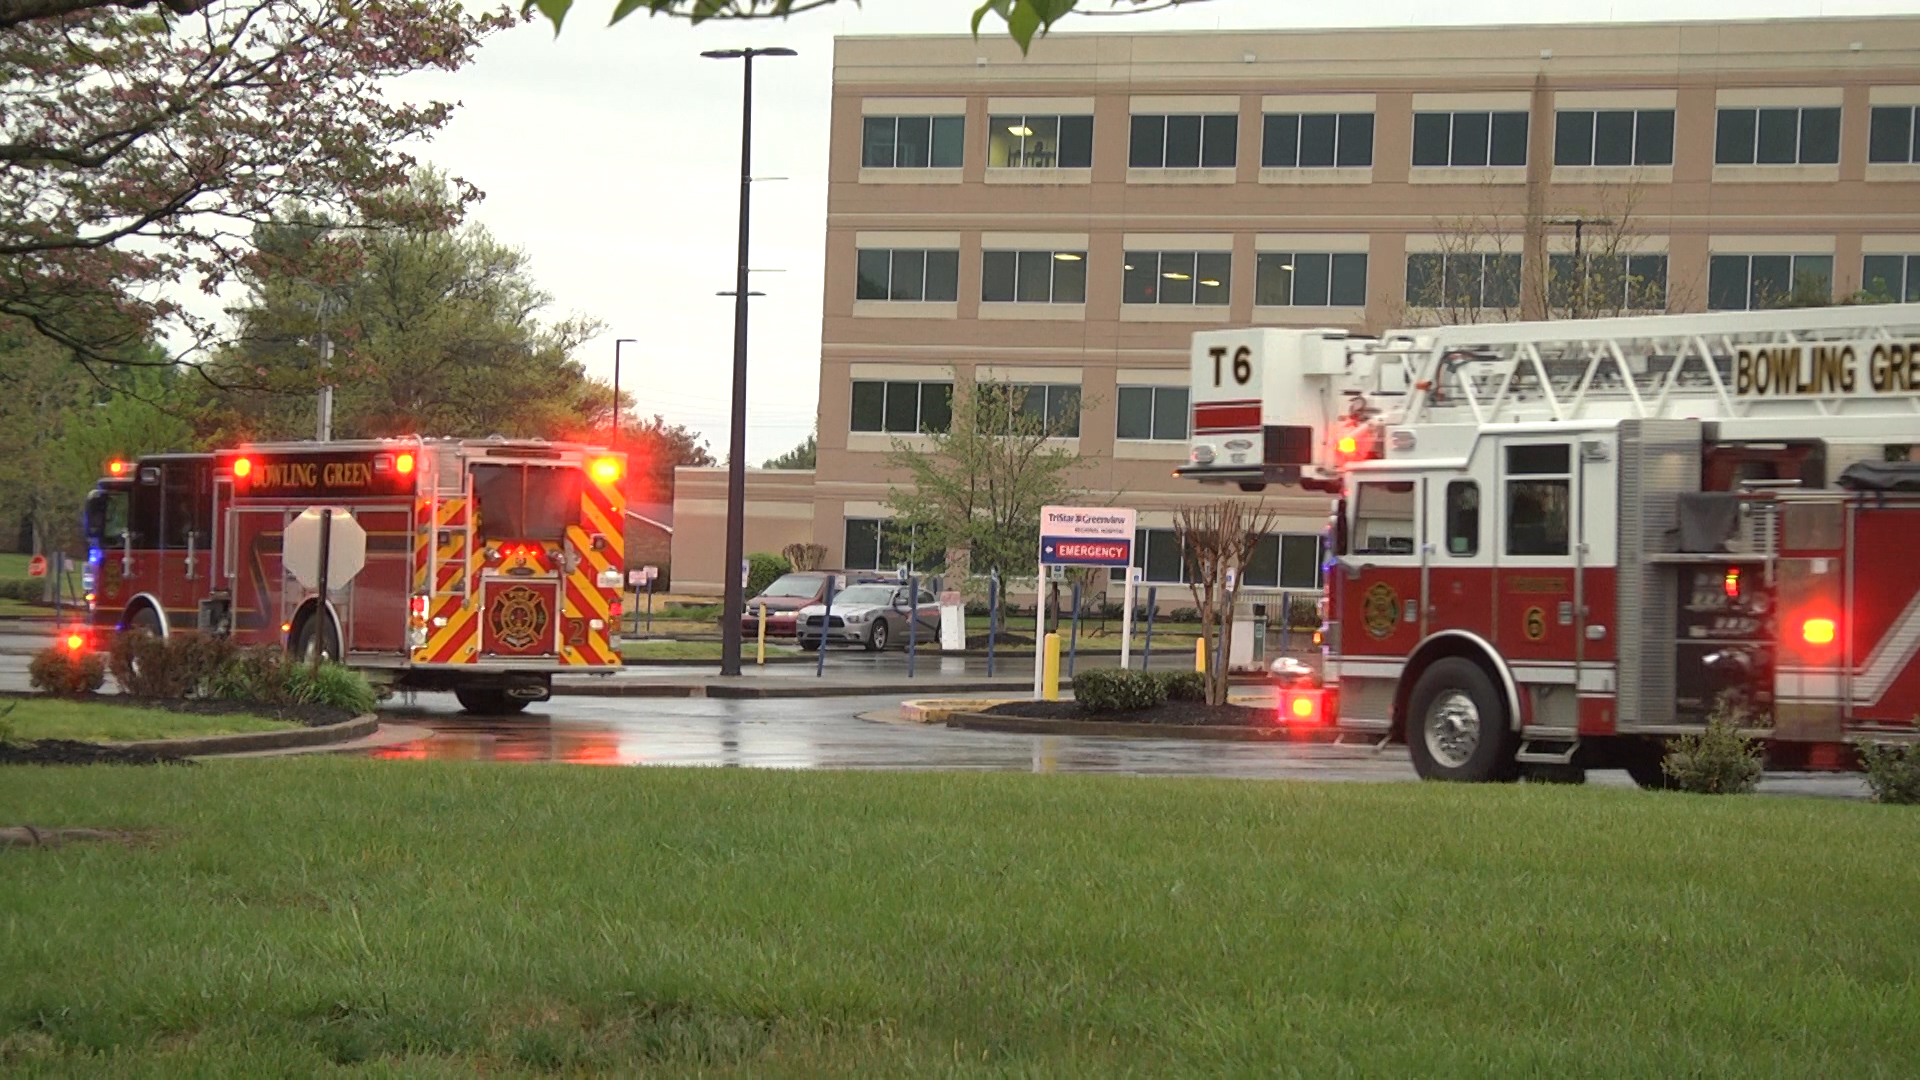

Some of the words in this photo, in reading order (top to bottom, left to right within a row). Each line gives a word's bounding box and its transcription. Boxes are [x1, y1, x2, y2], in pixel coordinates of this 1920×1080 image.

[1208, 345, 1252, 388] T6
[1737, 346, 1856, 396] BOWLING
[252, 463, 317, 488] BOWLING
[323, 462, 373, 487] GREEN
[1048, 513, 1075, 523] TriStar
[1082, 513, 1126, 524] Greenview
[1059, 545, 1123, 558] EMERGENCY
[568, 619, 585, 644] 2
[1524, 606, 1545, 641] 6
